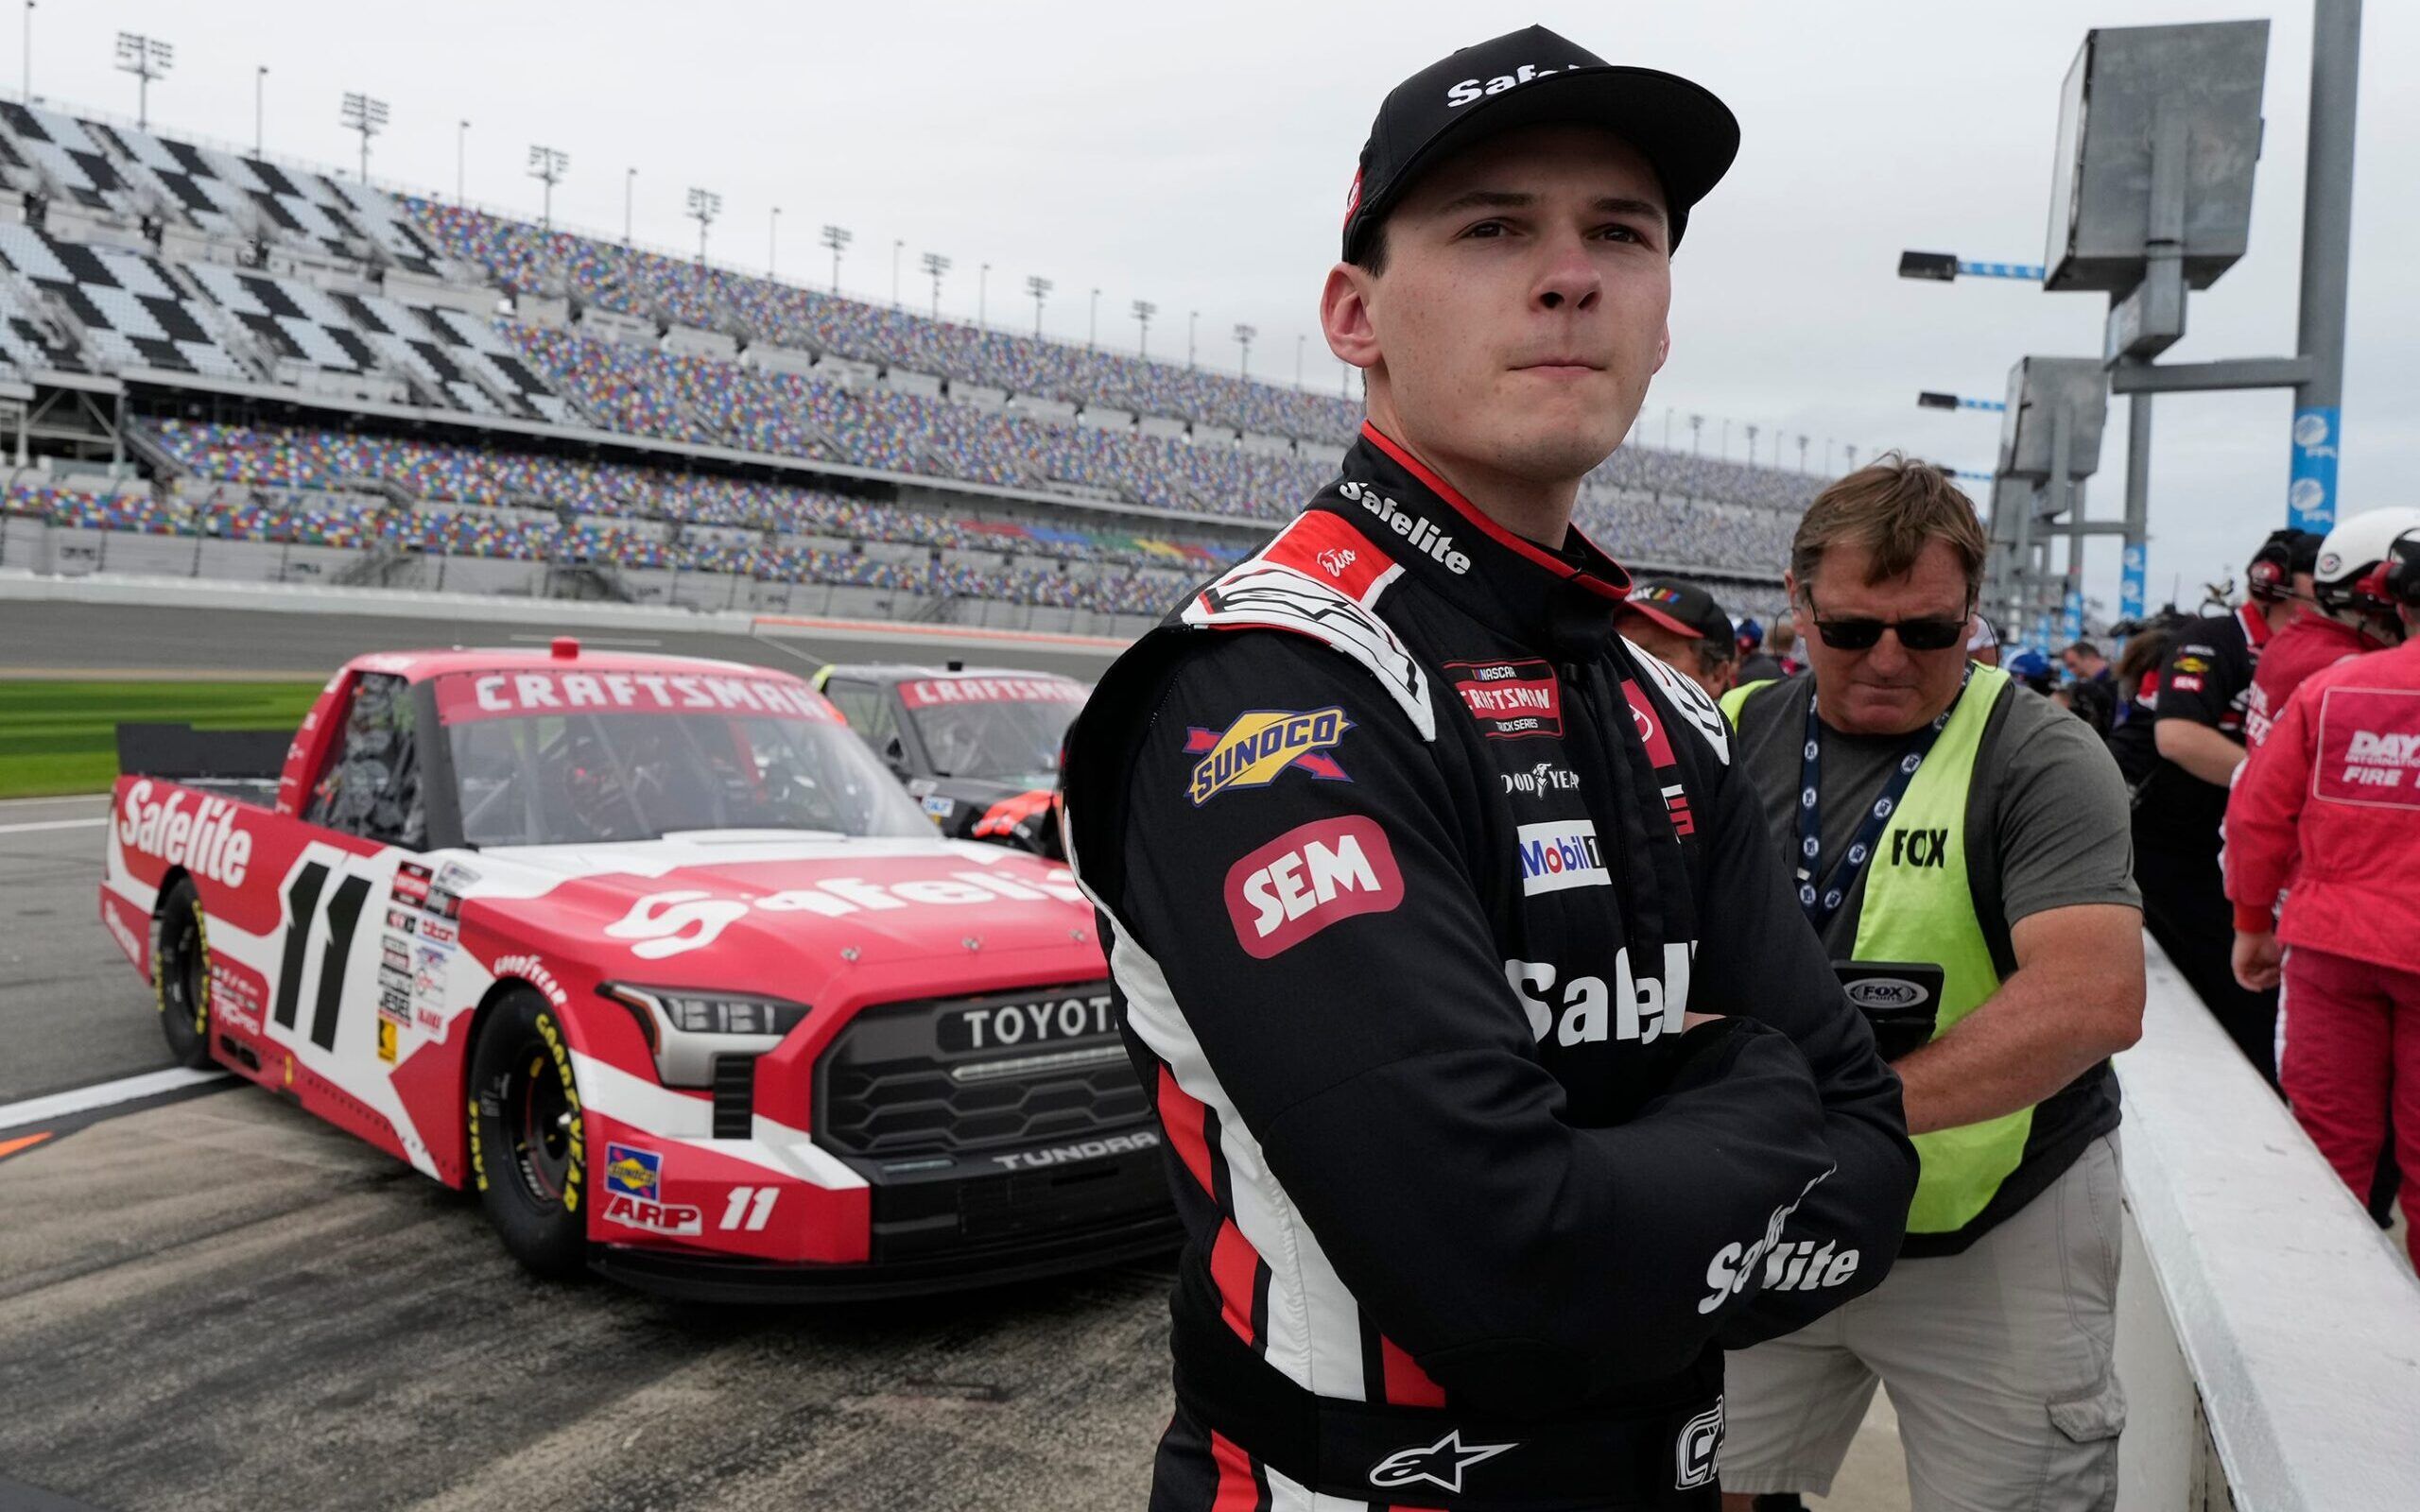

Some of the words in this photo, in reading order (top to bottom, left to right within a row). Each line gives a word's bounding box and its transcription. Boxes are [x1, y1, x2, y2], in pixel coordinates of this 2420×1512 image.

[1339, 481, 1471, 576] Safelite
[1479, 666, 1517, 681] NASCAR
[475, 674, 830, 720] CRAFTSMAN
[1513, 718, 1539, 730] SERIES
[1197, 713, 1338, 799] SUNOCO
[2342, 765, 2404, 787] FIRE
[120, 780, 252, 888] Safelite
[1892, 828, 1948, 868] FOX
[1519, 835, 1590, 879] Mobil
[1588, 837, 1601, 868] 1
[1243, 834, 1382, 937] SEM
[274, 861, 372, 1053] 11
[1863, 986, 1903, 998] FOX
[962, 996, 1119, 1048] TOYOT
[992, 1131, 1160, 1170] TUNDRA
[610, 1194, 698, 1228] ARP
[718, 1186, 781, 1231] 11
